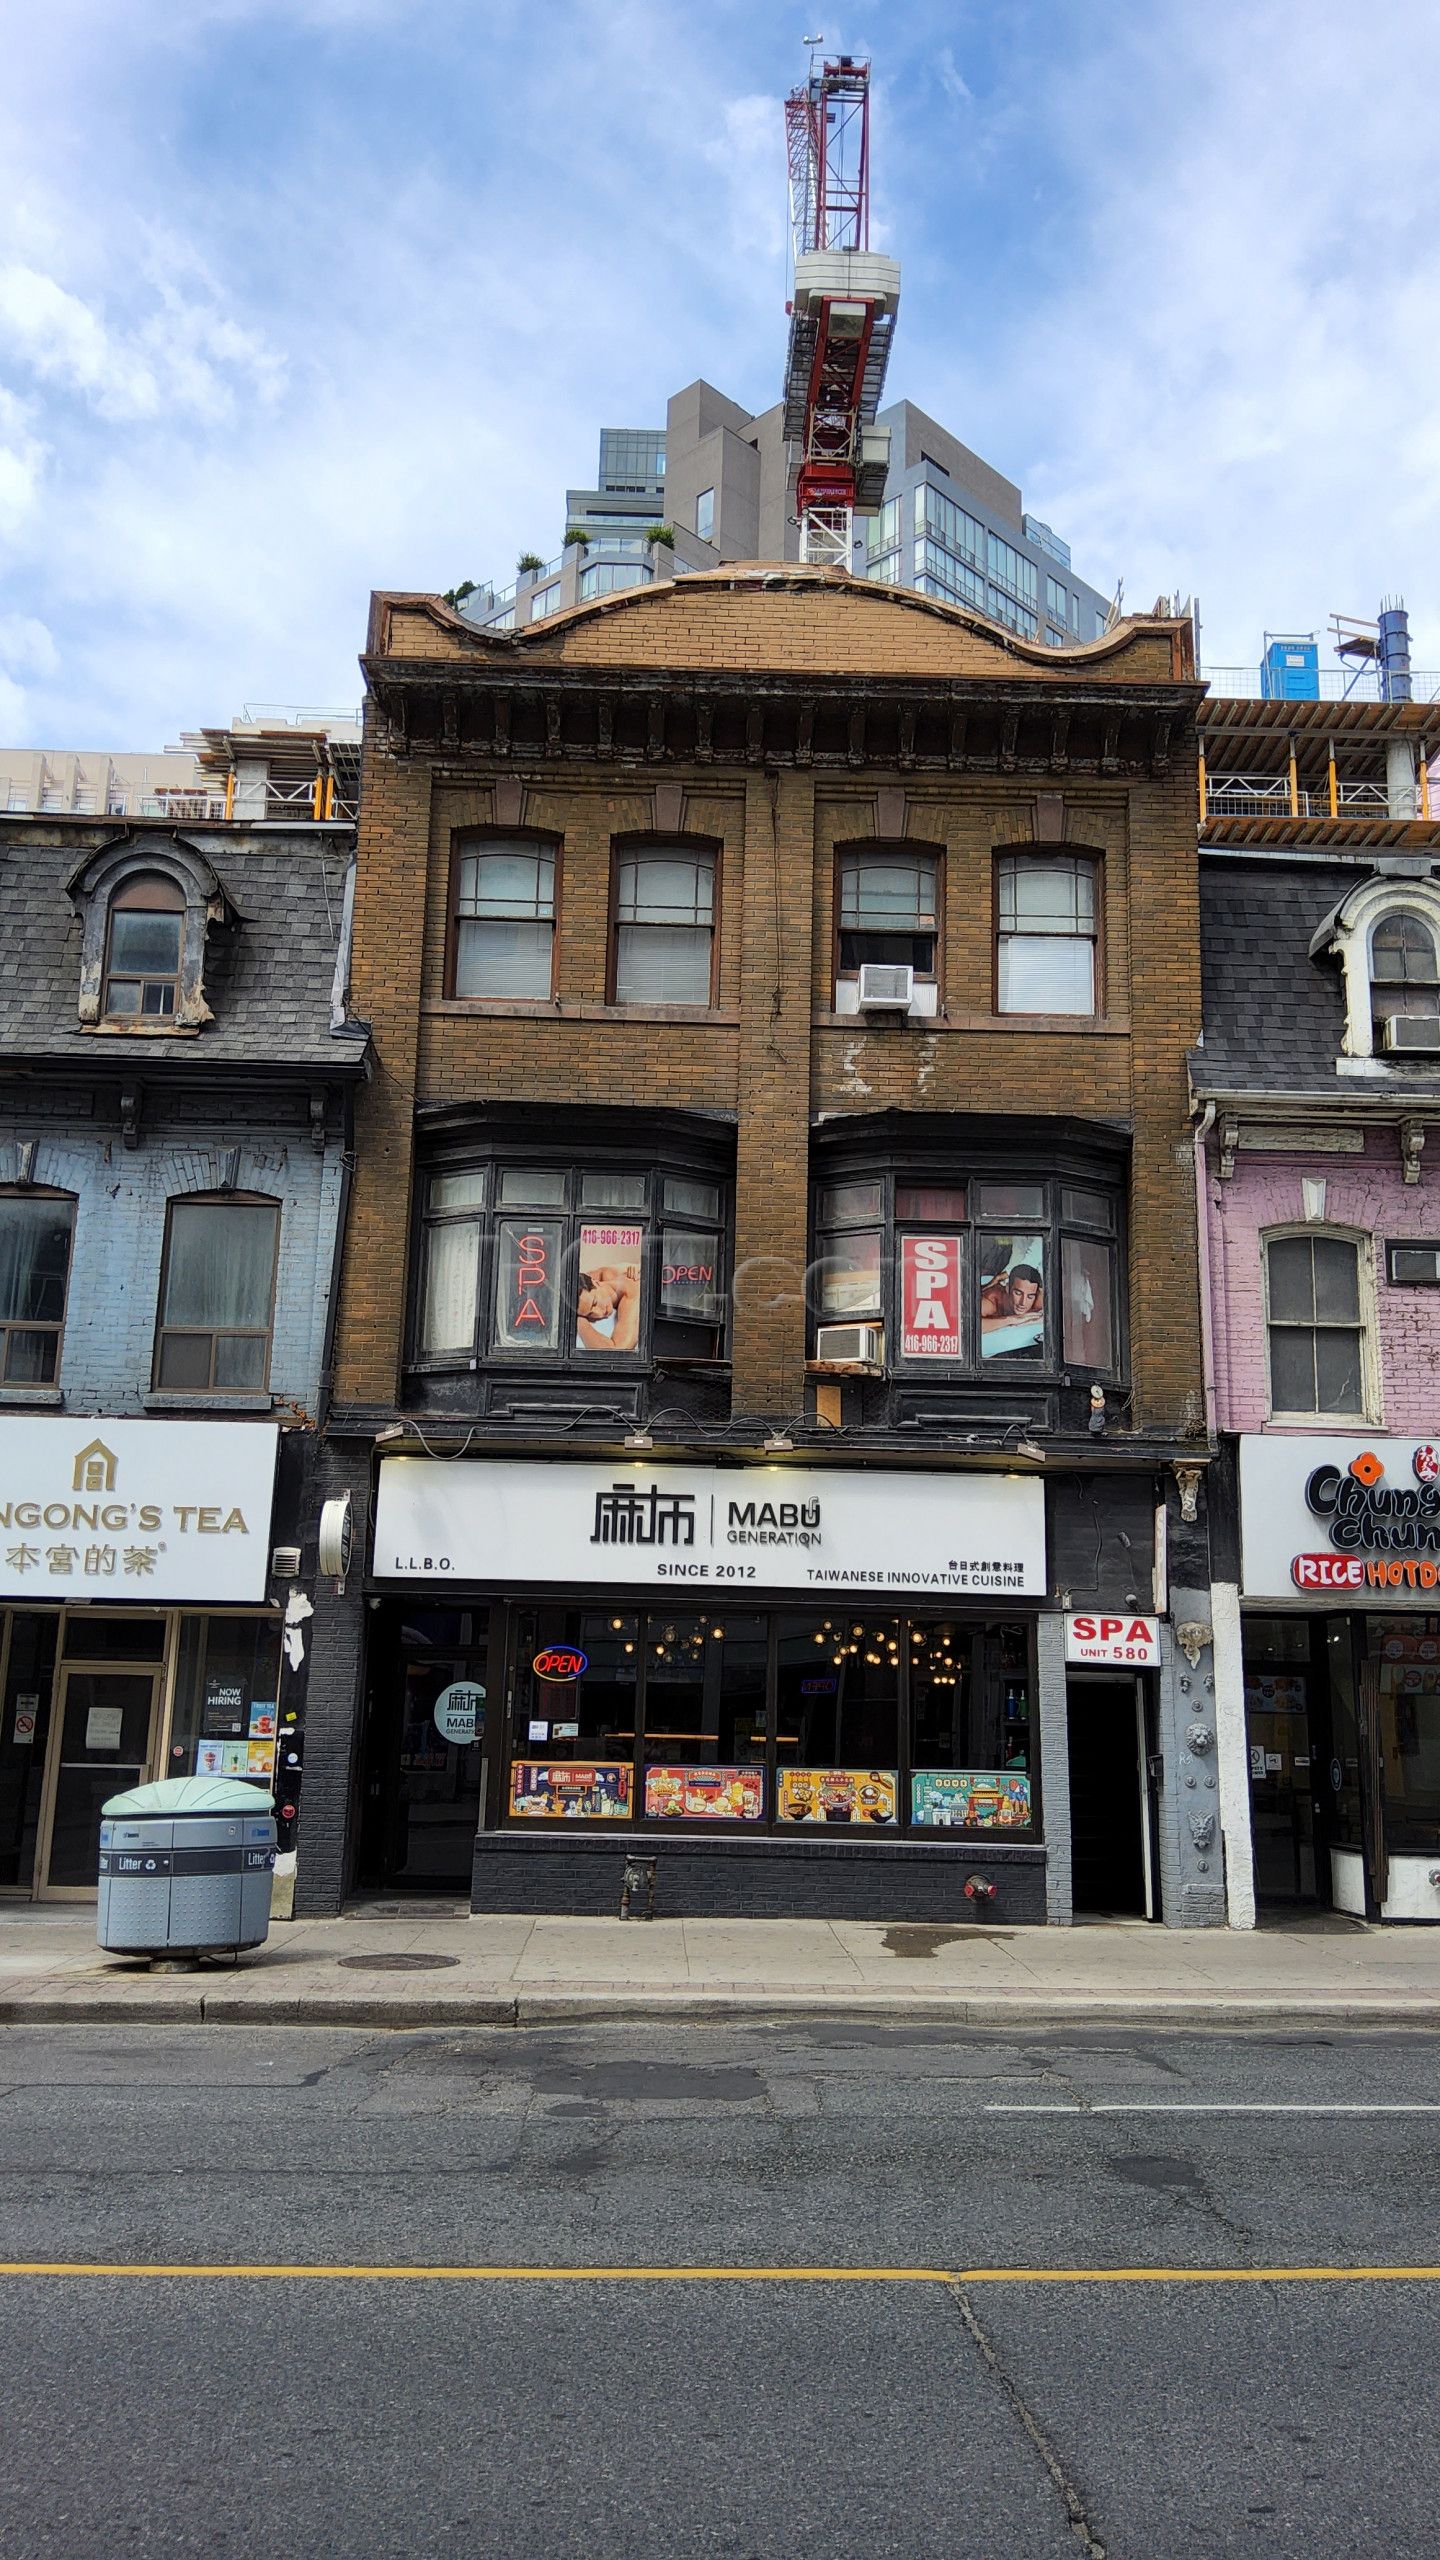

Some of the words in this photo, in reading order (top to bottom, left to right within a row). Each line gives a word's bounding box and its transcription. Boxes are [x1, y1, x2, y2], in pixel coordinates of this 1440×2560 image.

[582, 1228, 641, 1246] 416-966-2317
[515, 1235, 546, 1327] SPA
[661, 1265, 713, 1284] OPEN
[913, 1241, 950, 1330] SPA
[904, 1334, 958, 1353] 416-966-2317
[173, 1505, 249, 1534] TEA
[728, 1498, 821, 1528] MABU
[726, 1530, 822, 1547] GENERATION
[5, 1543, 158, 1576] 本宮的茶
[395, 1557, 455, 1571] L.L.B.O.
[948, 1560, 1024, 1573] 台日式創意料理
[657, 1564, 709, 1577] SINCE
[715, 1565, 756, 1578] 2012
[807, 1569, 884, 1583] TAIWANESE
[887, 1572, 968, 1586] INNOVATIVE
[971, 1574, 1024, 1587] CUISINE
[1298, 1557, 1362, 1585] RICE
[1366, 1560, 1440, 1588] HOTD
[1072, 1617, 1154, 1643] SPA
[1080, 1648, 1107, 1658] UNIT
[1113, 1646, 1148, 1660] 580
[536, 1655, 583, 1673] OPEN
[207, 1696, 241, 1706] HIRING
[219, 1688, 241, 1696] NOW
[446, 1718, 475, 1728] MAB
[118, 1857, 142, 1871] Litter
